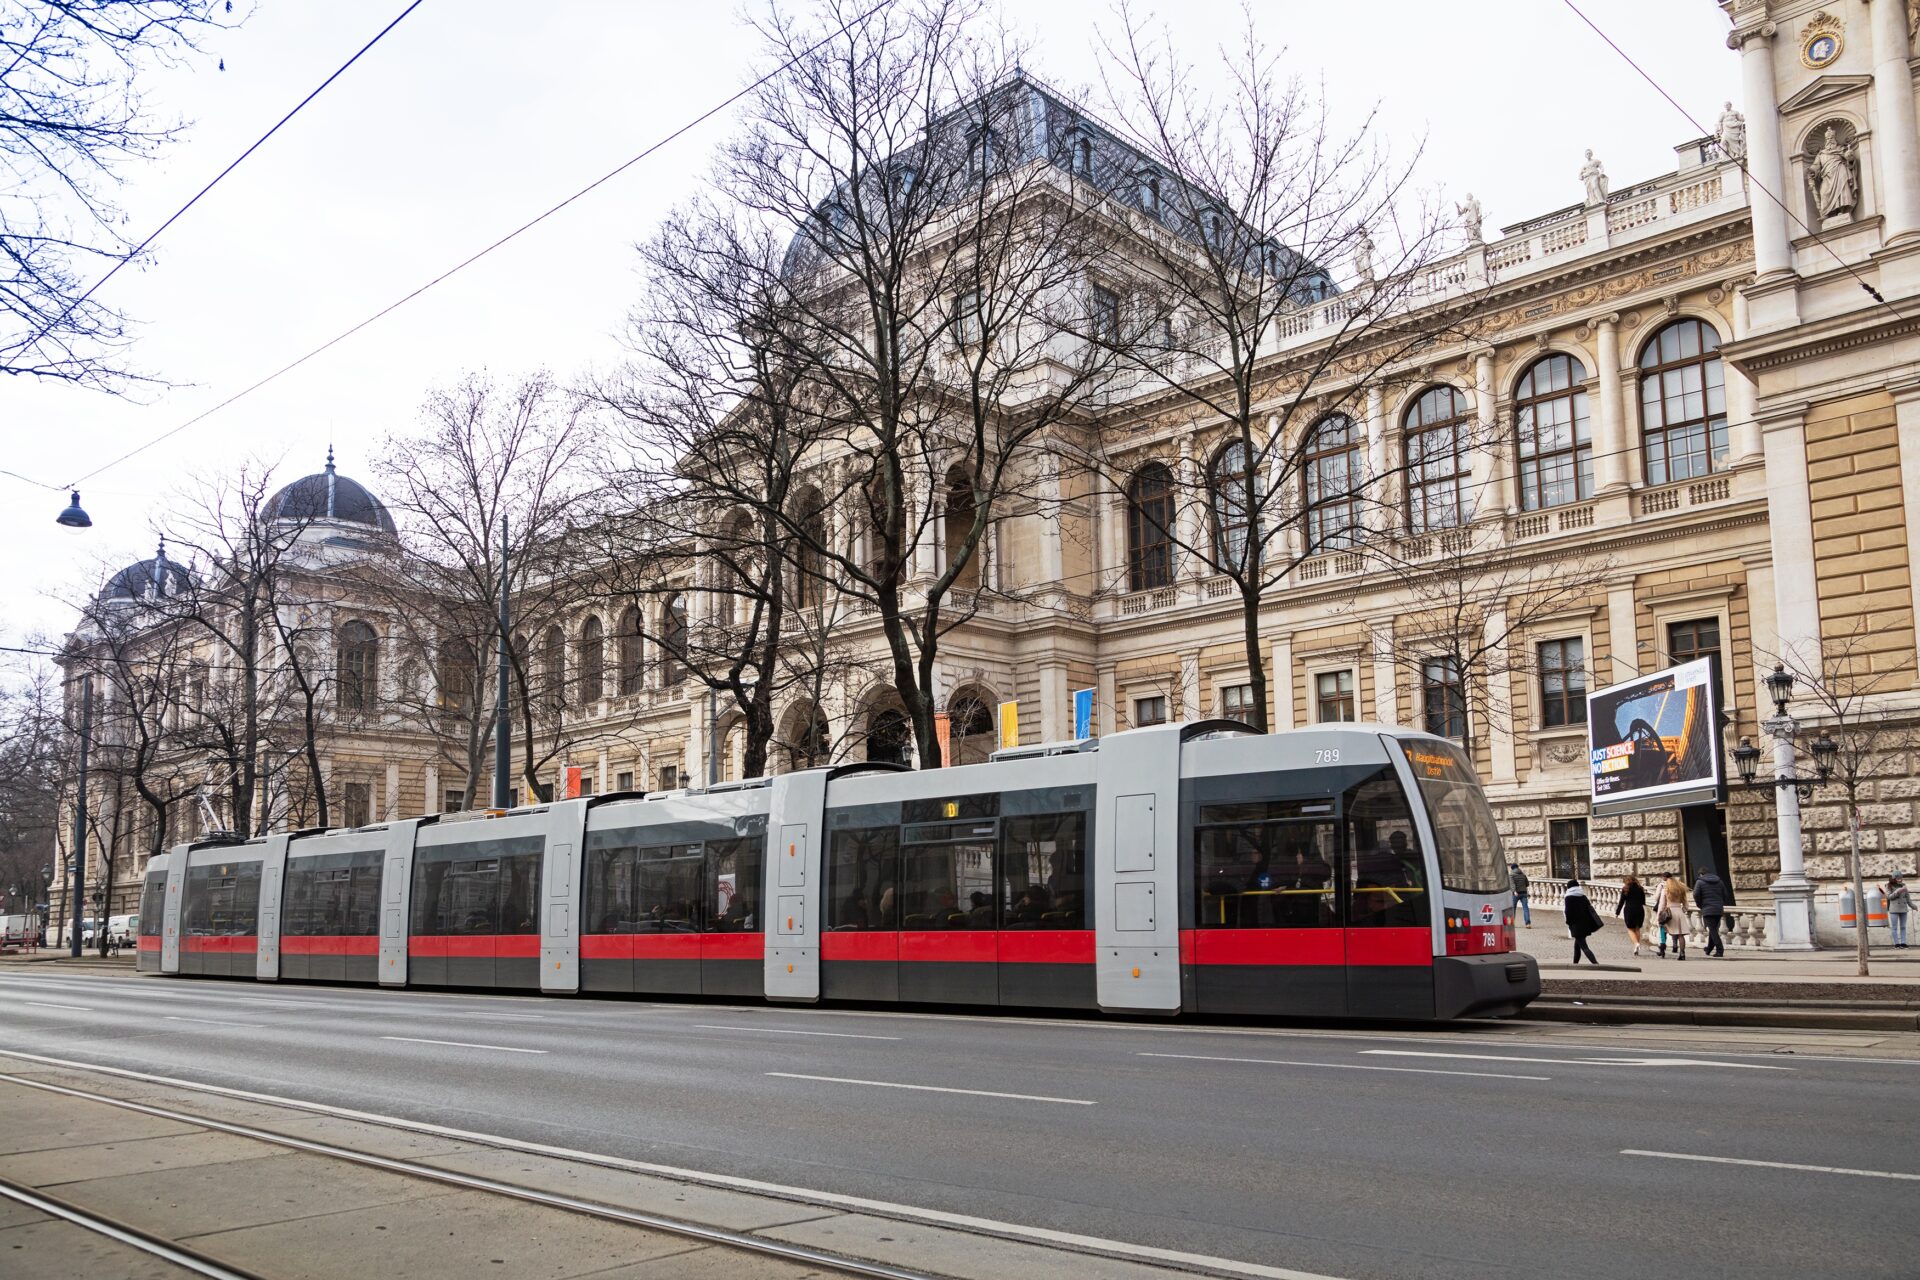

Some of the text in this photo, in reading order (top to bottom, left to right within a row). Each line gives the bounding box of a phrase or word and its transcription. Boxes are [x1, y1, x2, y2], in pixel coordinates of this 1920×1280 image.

[1315, 749, 1340, 763] 789
[1592, 749, 1606, 761] JUST
[1592, 761, 1602, 775] NO
[948, 803, 955, 817] D
[1482, 932, 1495, 947] 789
